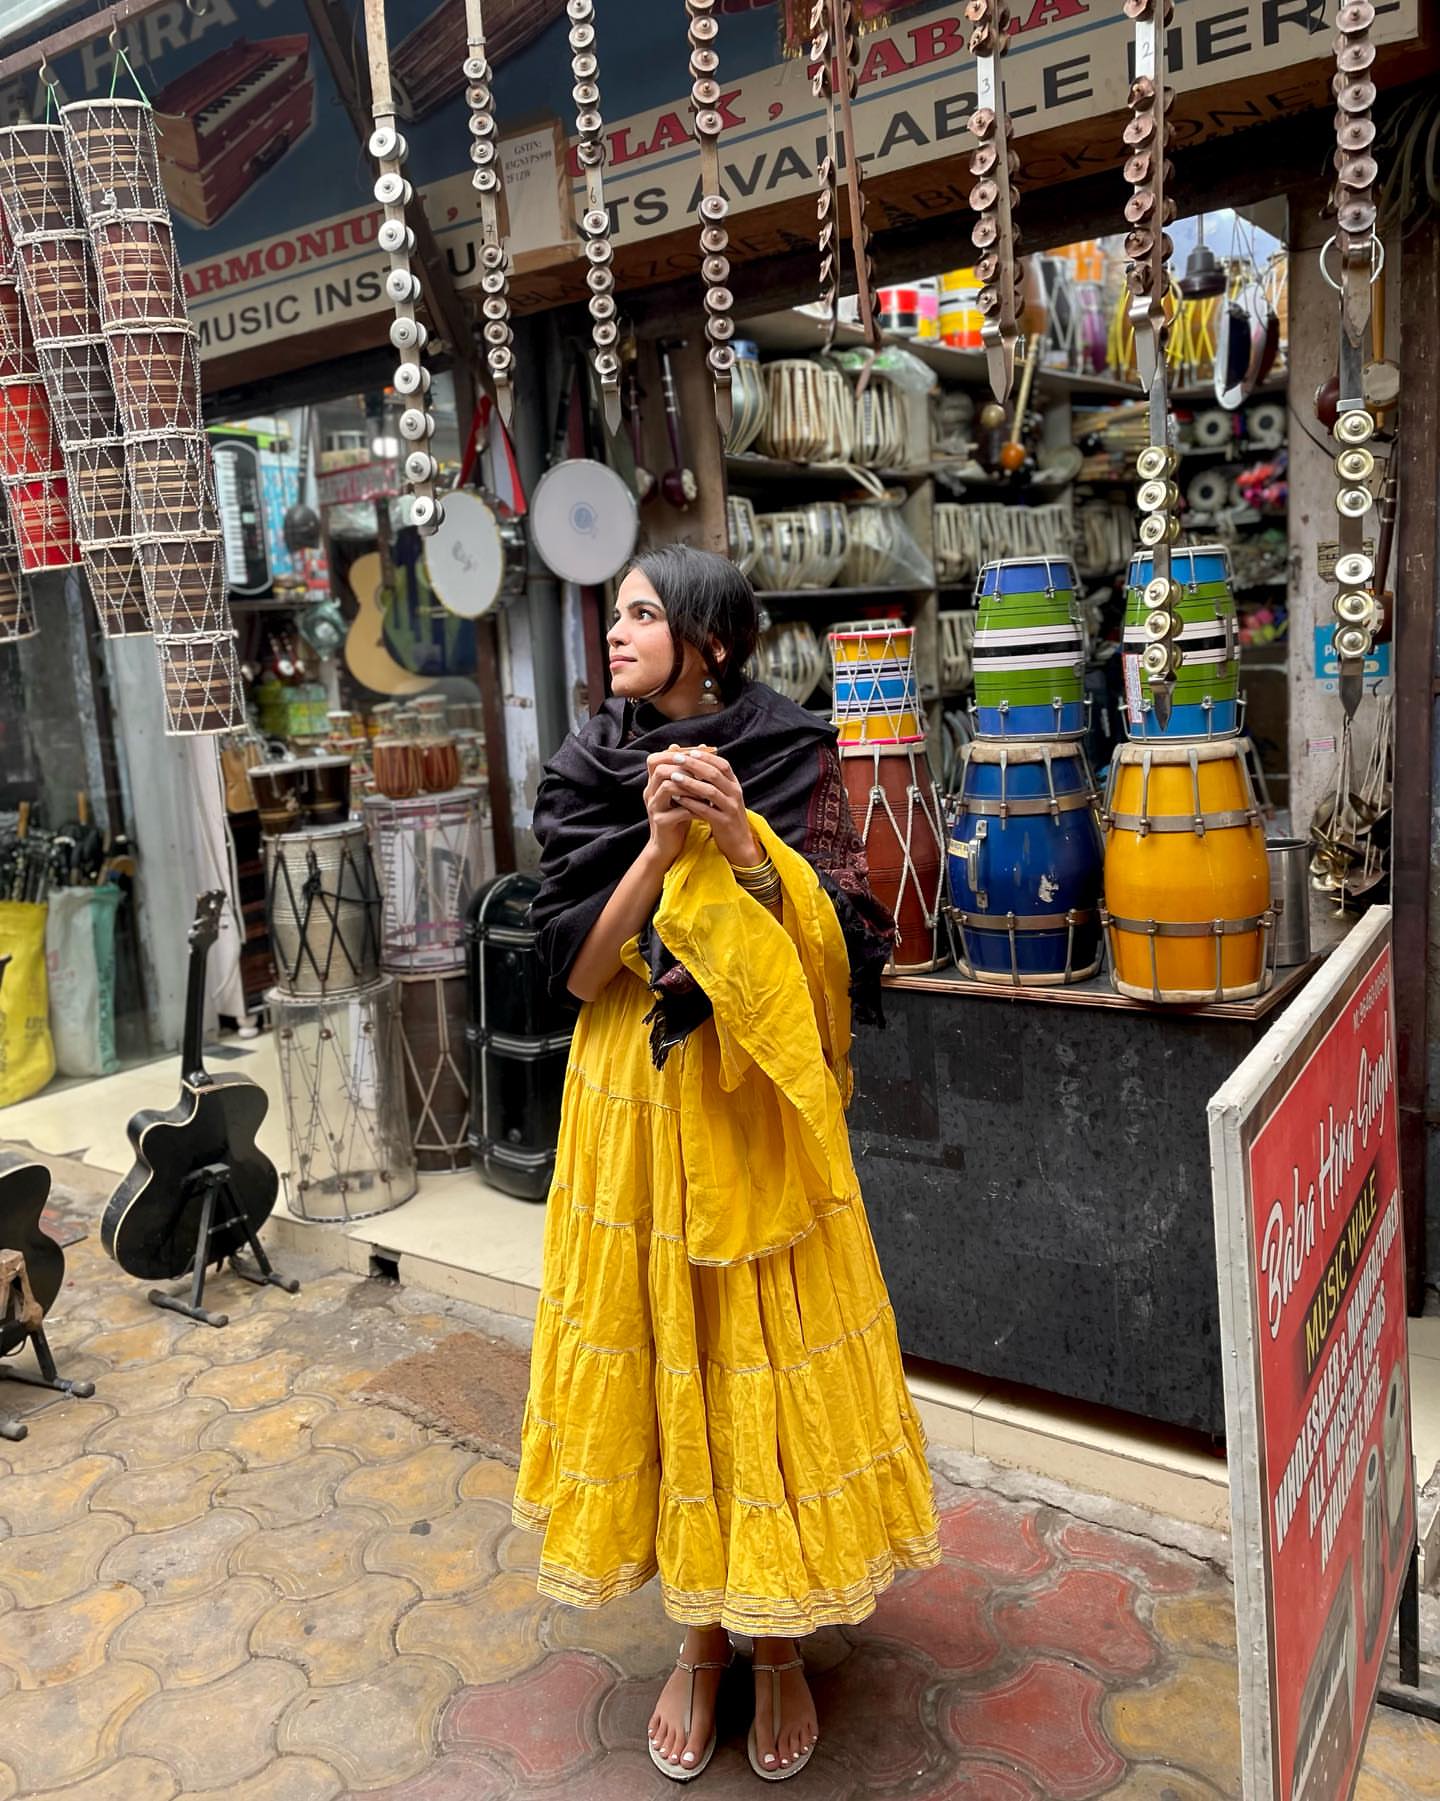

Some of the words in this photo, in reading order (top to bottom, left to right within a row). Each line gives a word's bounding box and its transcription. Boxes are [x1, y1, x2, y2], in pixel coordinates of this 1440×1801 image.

[807, 0, 1089, 98] TABA
[980, 78, 991, 94] 3
[1127, 0, 1401, 85] HER
[1142, 42, 1154, 58] 2
[1261, 1166, 1315, 1339] Baba
[1319, 1104, 1354, 1230] Hira
[1357, 1010, 1392, 1148] Singh
[1305, 1239, 1348, 1374] MUSIC
[1348, 1168, 1377, 1267] WALE
[1275, 1341, 1341, 1552] WHOLESALER
[1340, 1331, 1348, 1377] &
[1347, 1187, 1399, 1356] MANUFACTURER
[1308, 1451, 1326, 1540] ALL
[1325, 1347, 1362, 1487] MUSICAL
[1363, 1279, 1386, 1377] GOODS
[1321, 1405, 1364, 1575] AVAILABLE
